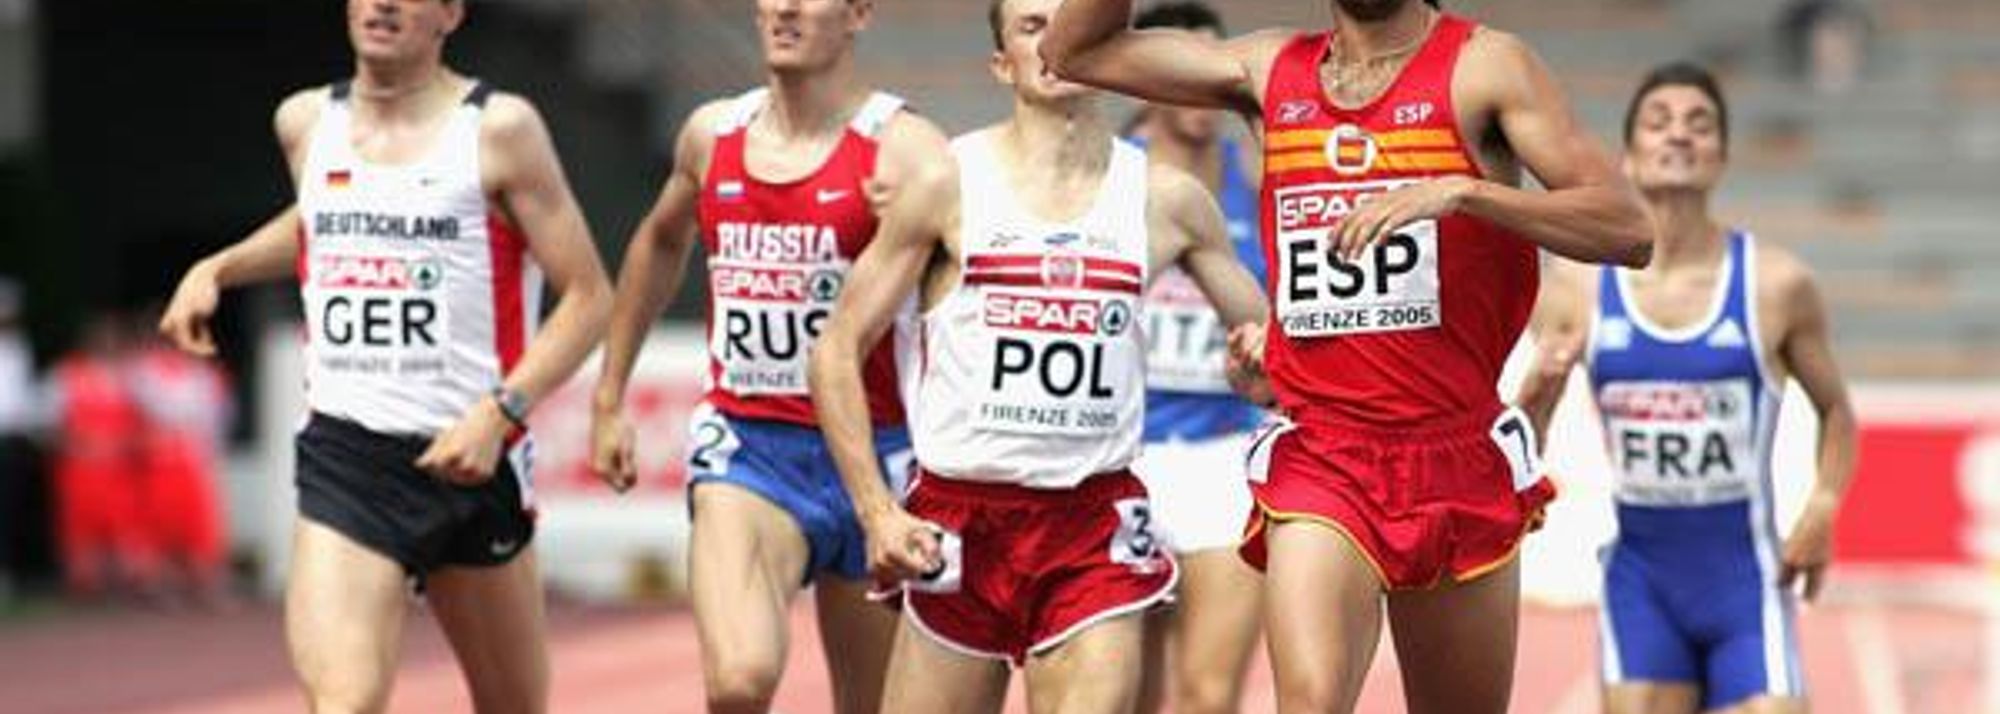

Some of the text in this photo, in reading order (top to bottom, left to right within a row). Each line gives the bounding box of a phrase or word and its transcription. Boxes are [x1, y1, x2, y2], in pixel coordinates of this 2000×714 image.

[1394, 103, 1434, 124] ESP
[314, 212, 460, 241] DEUTSCHLAND
[716, 222, 838, 261] RUSSIA
[320, 254, 410, 290] SPAR
[714, 267, 805, 302] SPAR
[1289, 233, 1419, 303] ESP
[323, 295, 438, 347] GER
[985, 292, 1100, 334] SPAR
[1376, 306, 1433, 327] 2005
[991, 336, 1114, 399] POL
[981, 403, 1068, 427] FIRENZE
[689, 421, 725, 469] 2
[1498, 415, 1534, 474] 7
[1622, 429, 1735, 478] FRA
[1130, 506, 1154, 558] 3
